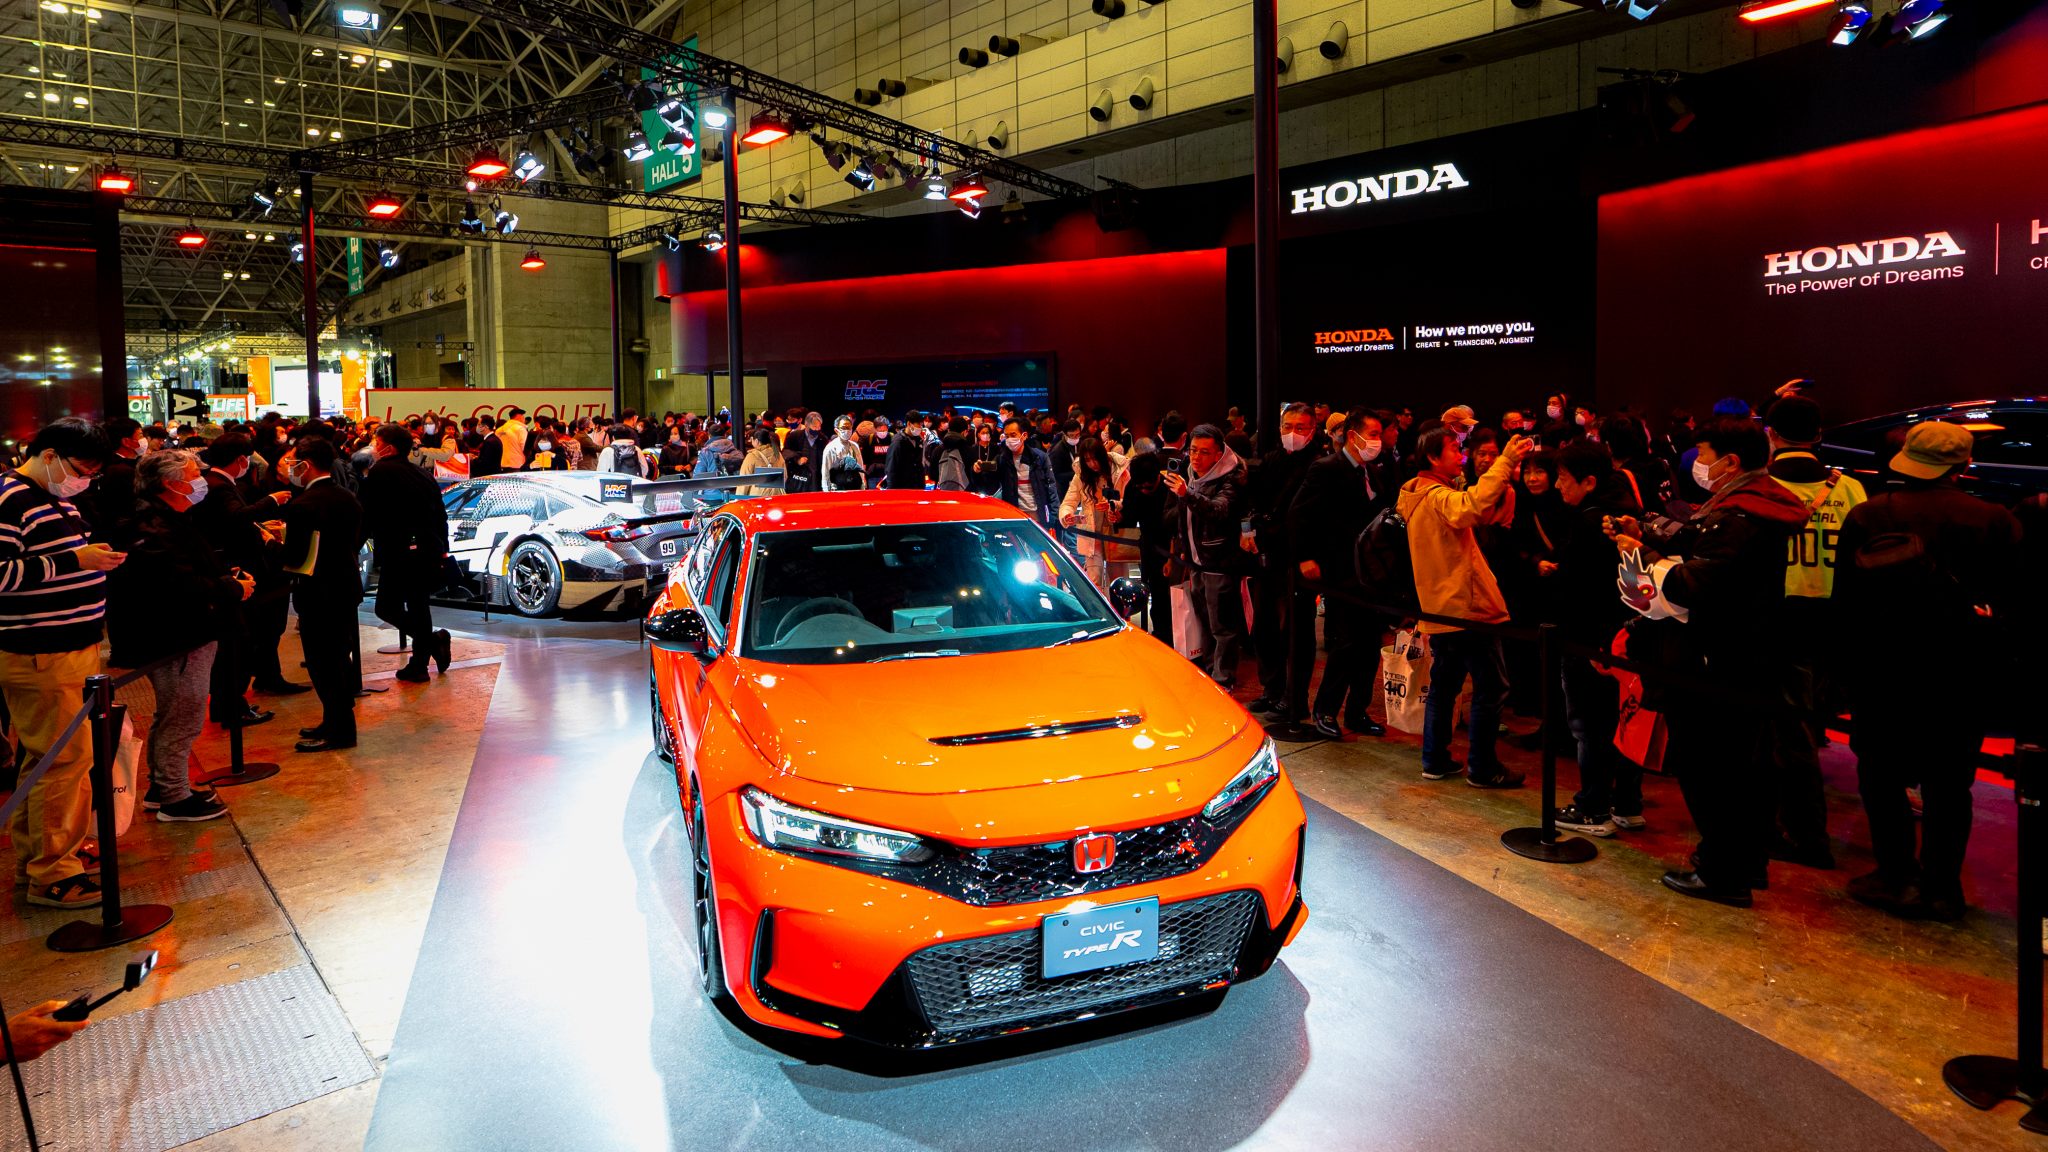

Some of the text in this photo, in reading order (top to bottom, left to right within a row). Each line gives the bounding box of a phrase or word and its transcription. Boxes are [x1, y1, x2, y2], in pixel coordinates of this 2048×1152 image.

[651, 153, 693, 185] HALL 5
[1291, 162, 1470, 215] HONDA
[1764, 231, 1966, 278] HONDA
[1765, 265, 1965, 296] The Power of Dreams
[1314, 328, 1394, 345] HONDA
[1415, 321, 1535, 338] How we move you.
[1315, 343, 1394, 354] The Power of Dreams
[1415, 336, 1535, 349] CREATE TRANSCEND, AUGMENT
[845, 379, 888, 397] HRC
[662, 542, 674, 554] 99
[1079, 920, 1125, 937] CIVIC
[1063, 929, 1143, 959] TYPE R
